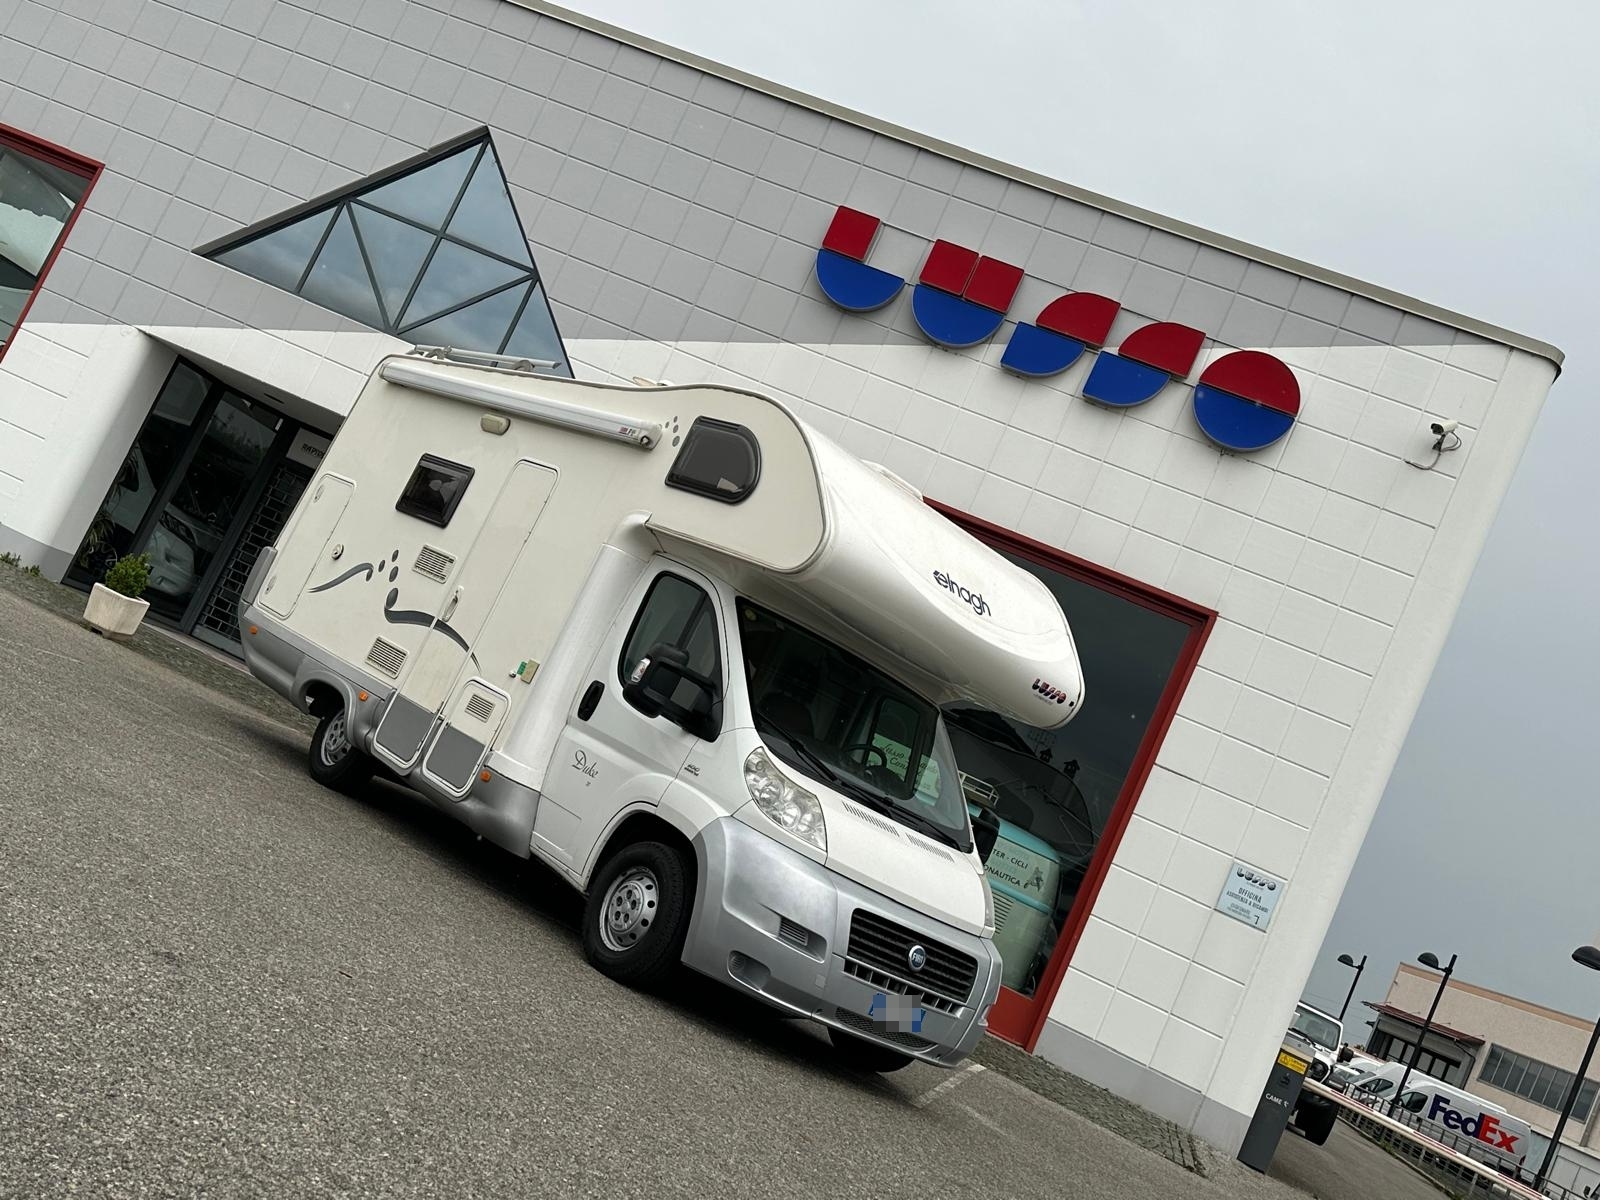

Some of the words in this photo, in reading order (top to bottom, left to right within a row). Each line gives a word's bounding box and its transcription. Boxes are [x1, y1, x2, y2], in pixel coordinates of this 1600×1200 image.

[816, 205, 1301, 452] LUSSO
[934, 570, 991, 616] elnagh
[572, 749, 599, 778] Duke
[992, 848, 1006, 859] TER
[1010, 856, 1029, 870] CICLI
[983, 864, 1021, 886] ONAUTICA
[1265, 1092, 1283, 1107] CAME
[1428, 1095, 1519, 1153] FedEx
